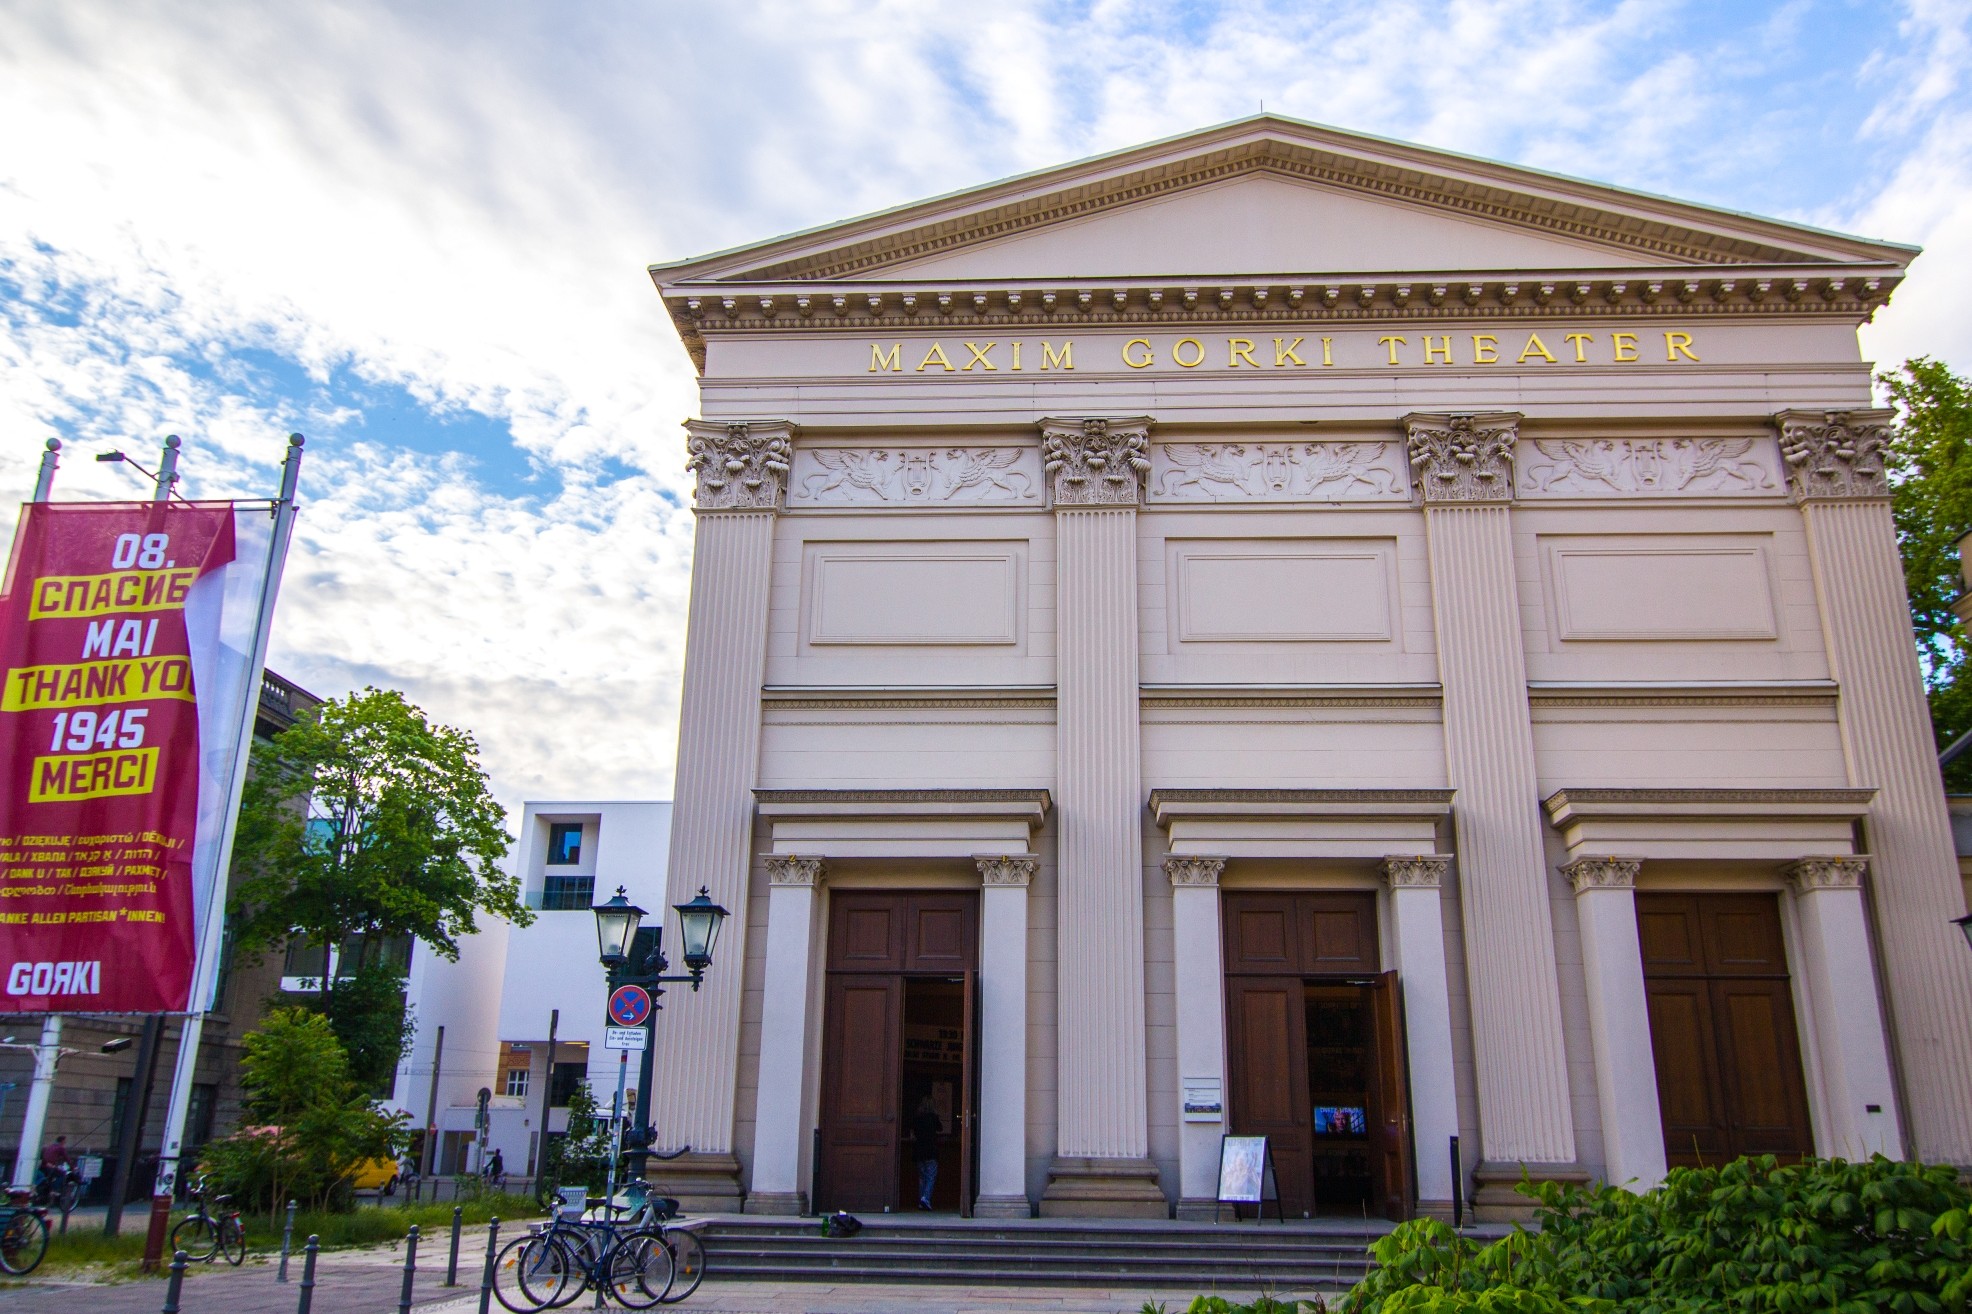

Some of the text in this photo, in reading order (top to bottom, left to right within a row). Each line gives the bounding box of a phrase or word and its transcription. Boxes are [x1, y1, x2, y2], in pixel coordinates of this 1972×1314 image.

[868, 331, 1700, 372] MAXIM GORKI THEATER
[112, 533, 176, 570] 08.
[82, 618, 159, 659] MAI
[17, 664, 131, 705] THANK
[50, 708, 149, 752] 1945
[38, 752, 149, 796] MERCI
[31, 912, 67, 924] ALLEN
